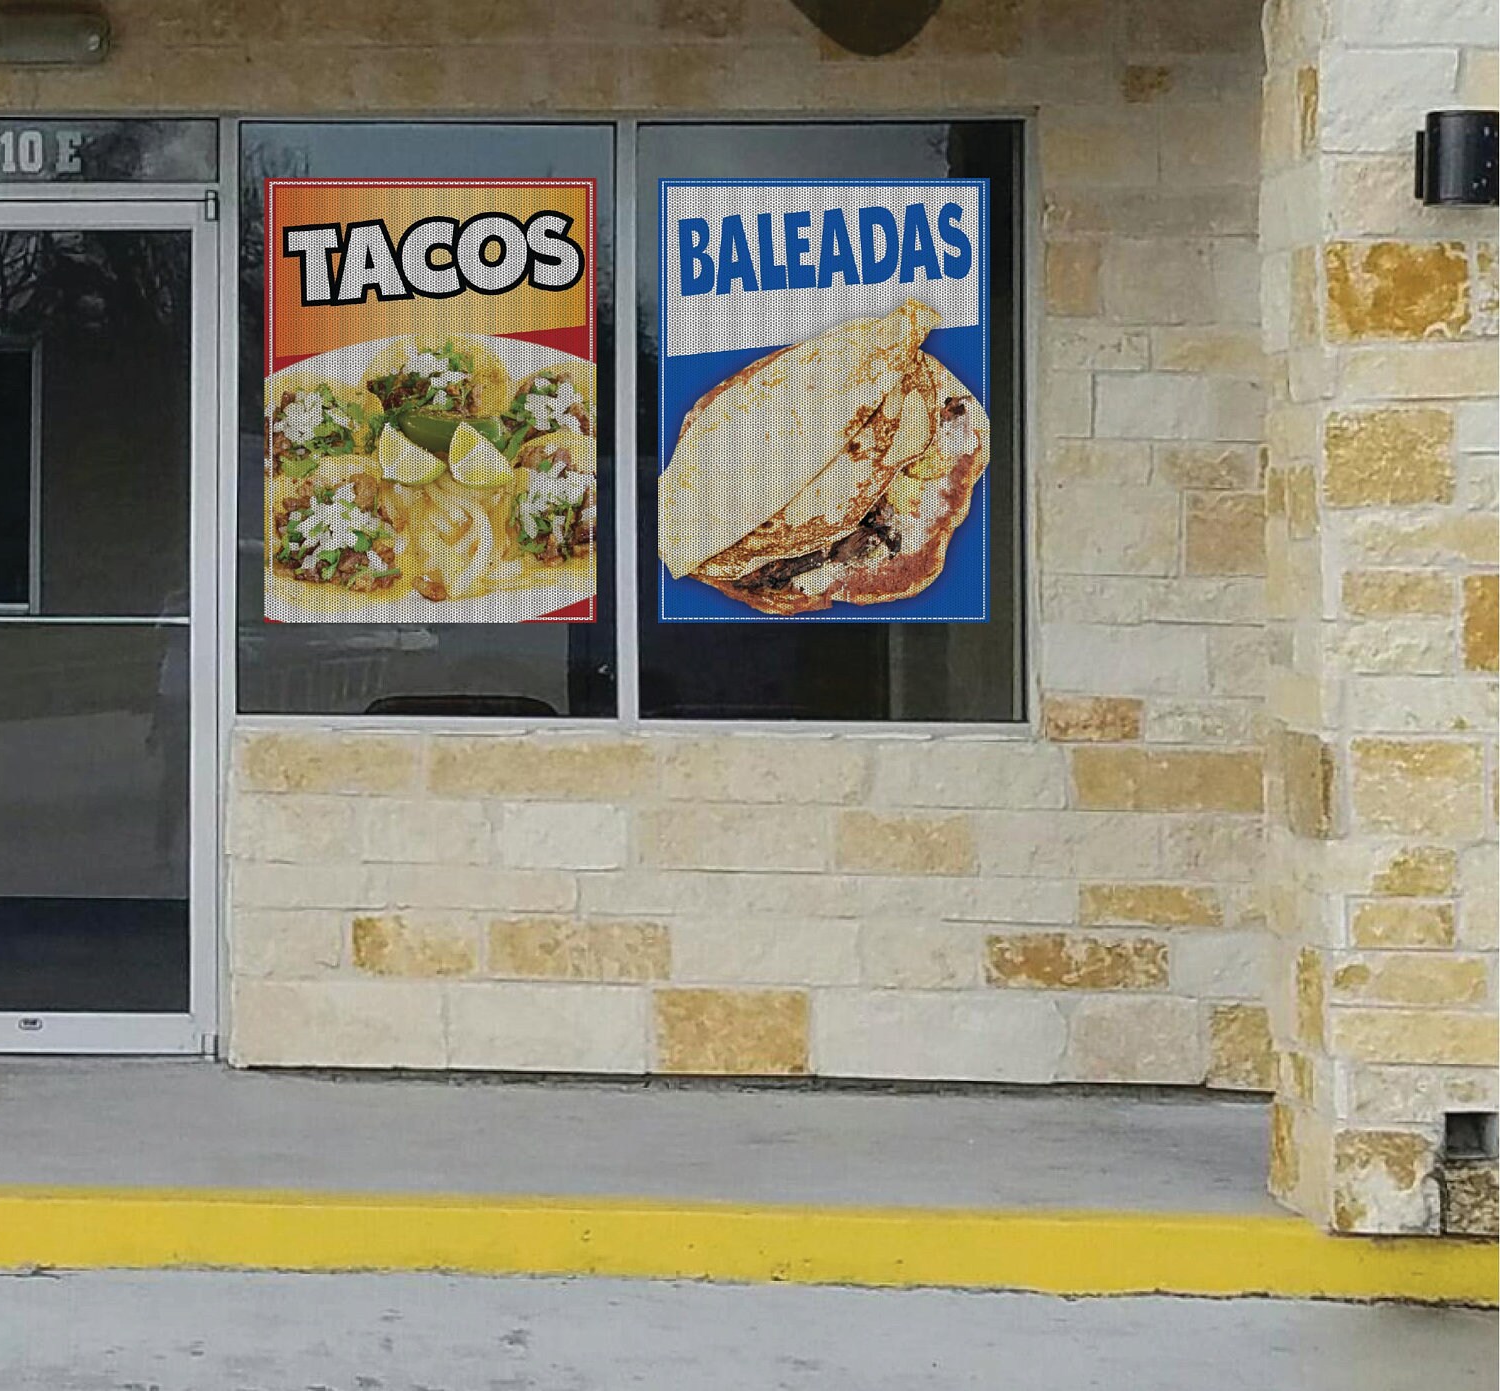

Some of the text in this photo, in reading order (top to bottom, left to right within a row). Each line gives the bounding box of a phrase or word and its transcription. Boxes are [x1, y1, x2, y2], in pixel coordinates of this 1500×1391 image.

[55, 130, 82, 174] E
[284, 211, 584, 305] TACOS
[678, 201, 973, 297] BALEADAS
